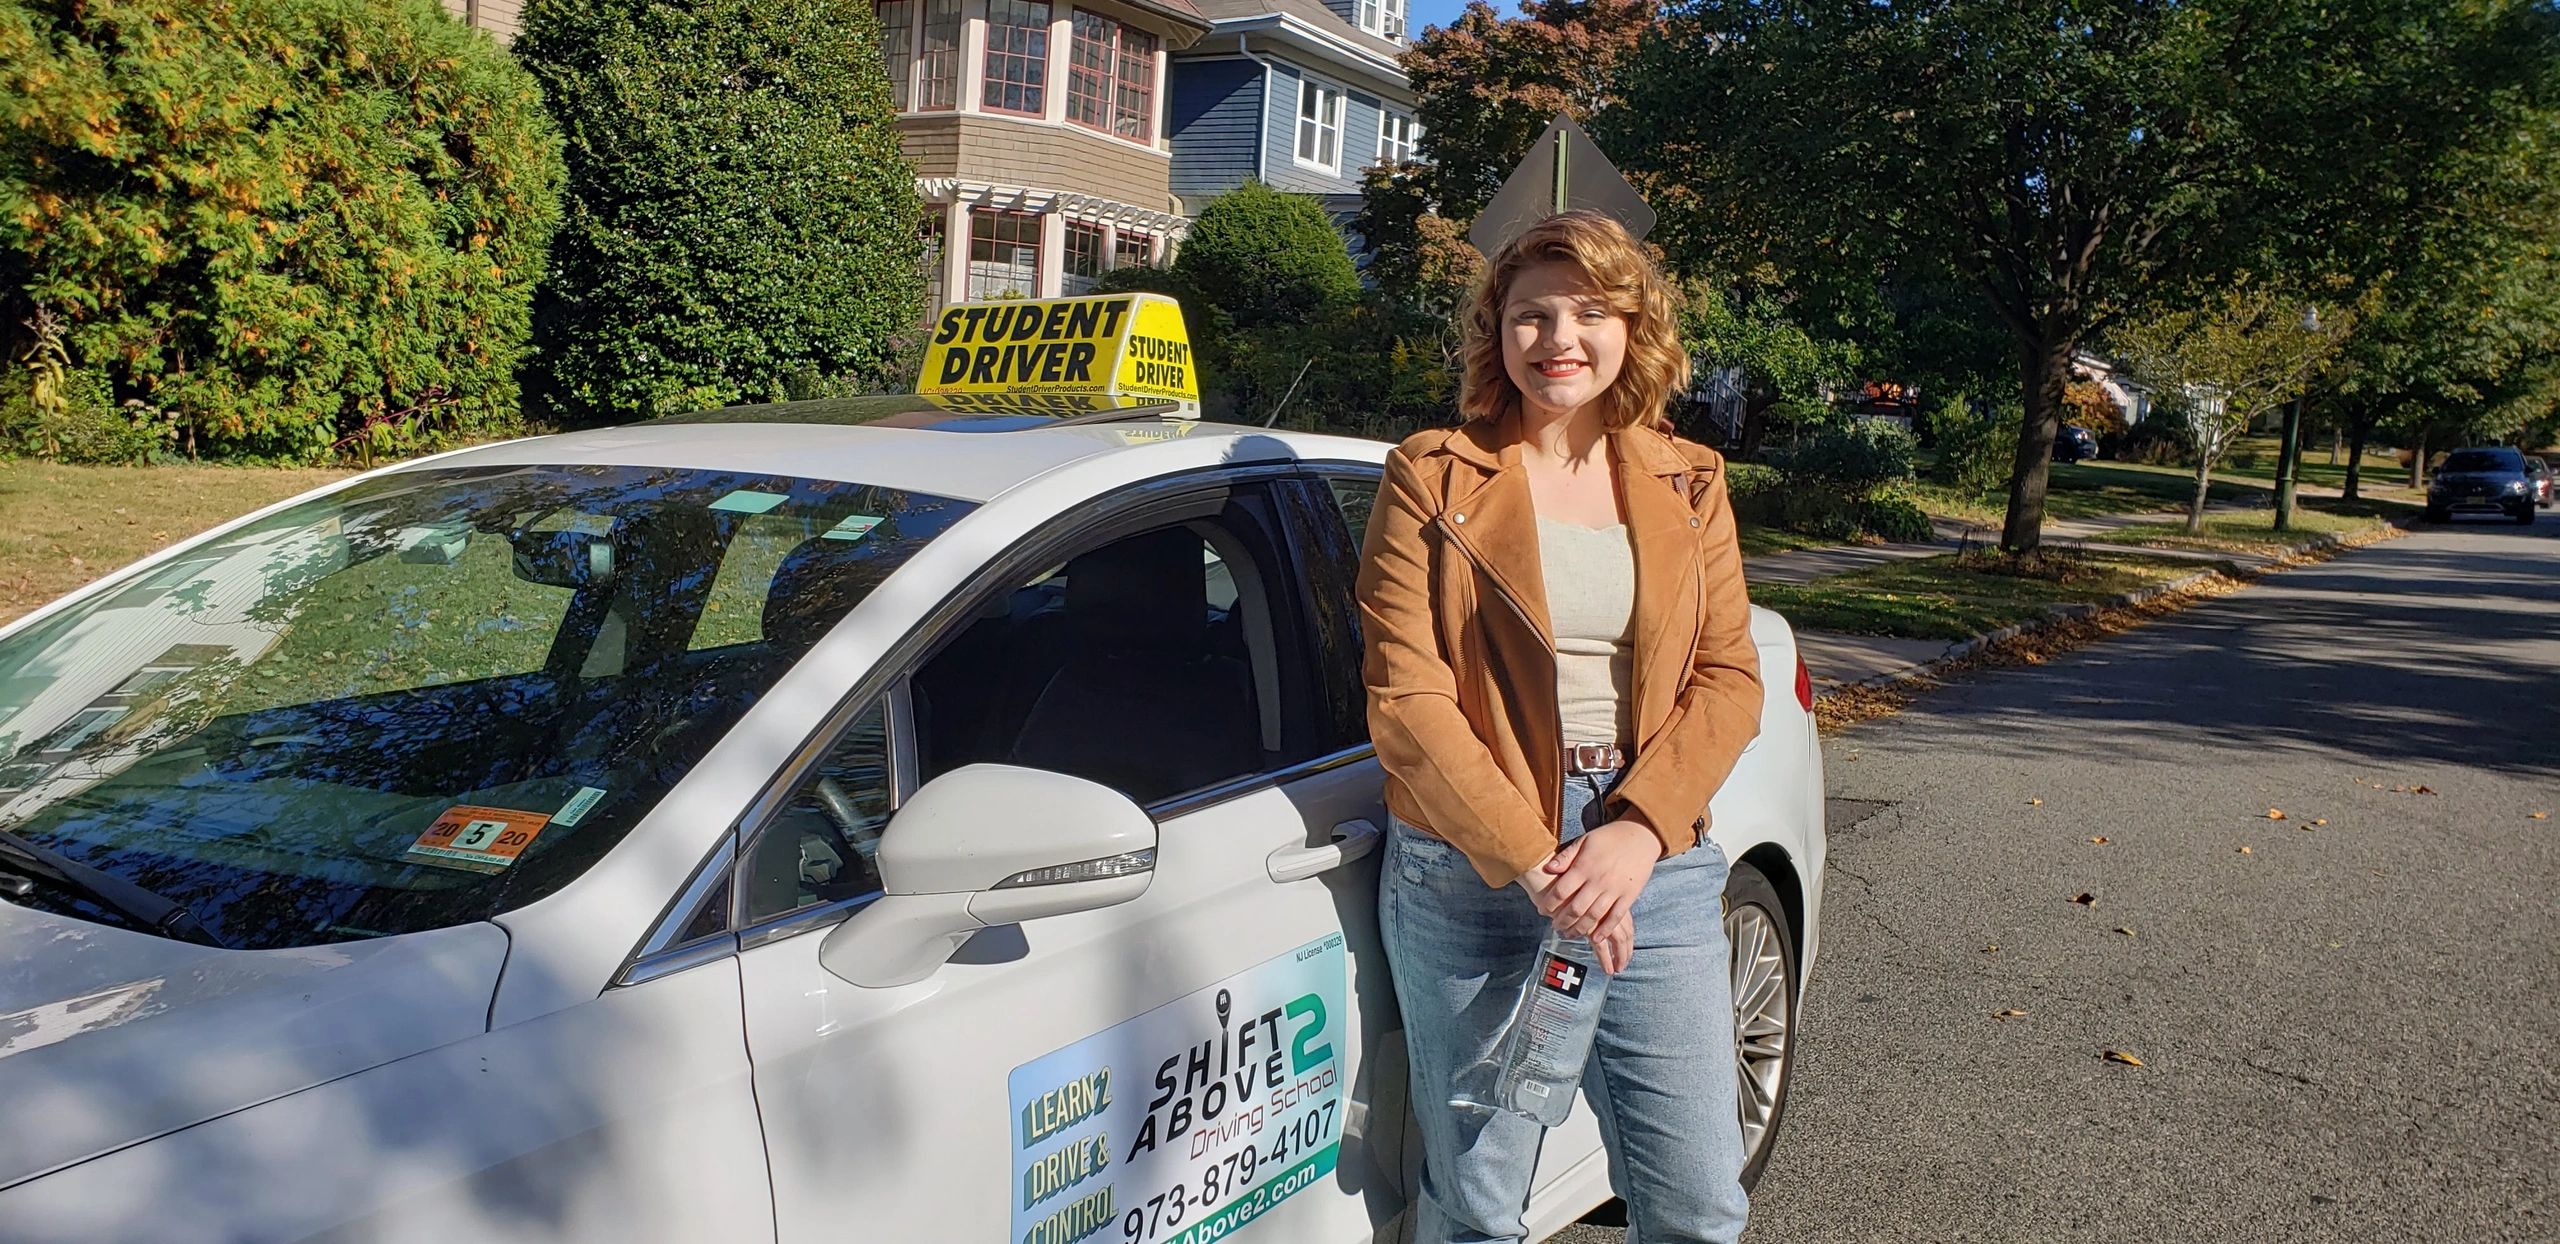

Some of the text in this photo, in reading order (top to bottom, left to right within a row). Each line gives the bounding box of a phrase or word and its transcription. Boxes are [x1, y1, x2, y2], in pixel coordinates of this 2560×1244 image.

[934, 300, 1129, 345] STUDENT
[1129, 334, 1189, 366] STUDENT
[940, 342, 1096, 385] DRIVER
[1006, 384, 1105, 394] StudentDriverProducts.com
[1118, 382, 1198, 400] StudentDriverProducts.com
[1135, 360, 1185, 389] DRIVER
[431, 822, 528, 847] 20 5 20
[1296, 951, 1304, 963] NJ
[1148, 989, 1284, 1113] SHIFT
[1285, 992, 1334, 1076] 2
[1026, 1065, 1113, 1144] LEARN 2
[1125, 1050, 1285, 1164] ABOVE
[1190, 1060, 1338, 1160] Driving School
[1028, 1131, 1111, 1206] DRIVE &
[1123, 1098, 1337, 1244] 973-879-4107
[1028, 1182, 1120, 1244] CONTROL
[1166, 1163, 1315, 1244] Above2.com
